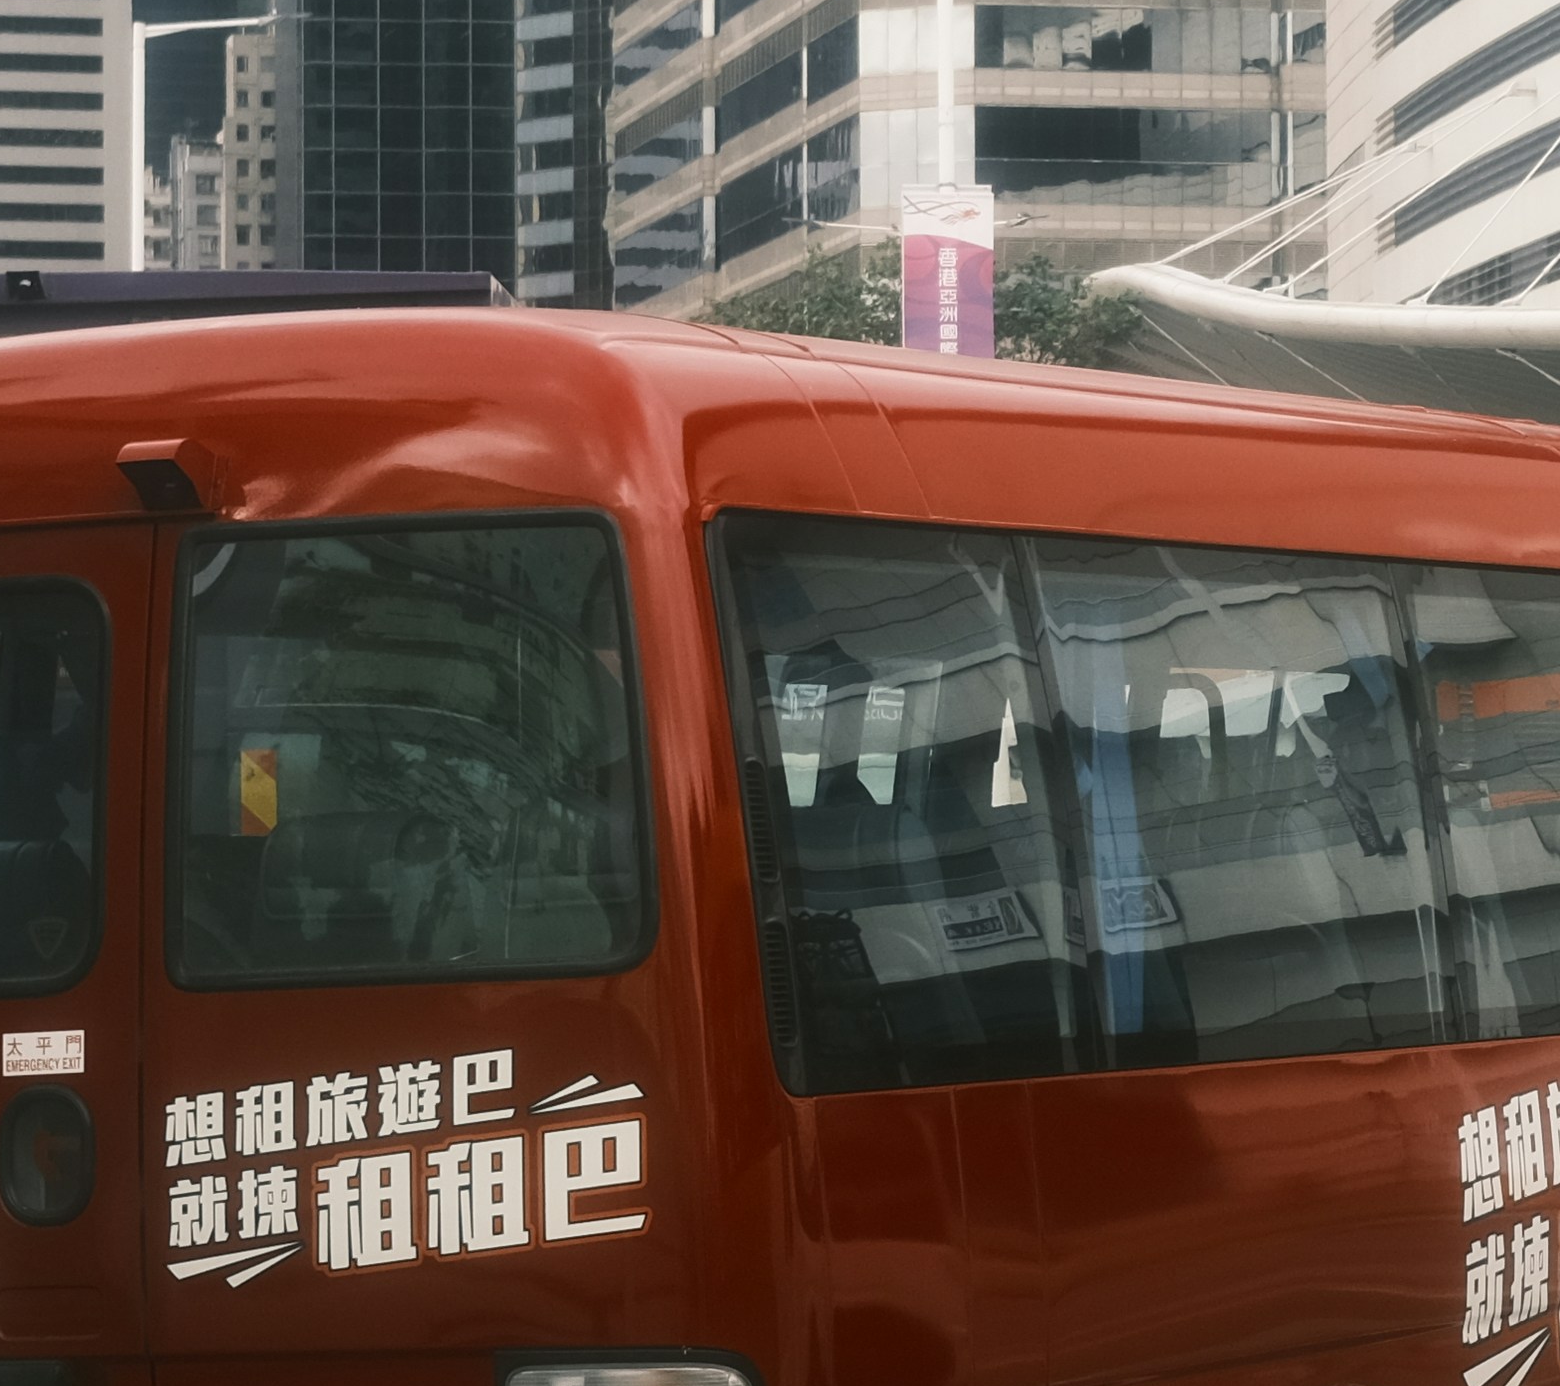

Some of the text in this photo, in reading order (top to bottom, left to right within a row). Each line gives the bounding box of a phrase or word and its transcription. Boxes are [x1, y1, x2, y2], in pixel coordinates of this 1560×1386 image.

[6, 1034, 82, 1057] 太平門
[6, 1056, 82, 1072] EMERGENCY EXIT
[165, 1047, 516, 1168] 想租旅遊巴
